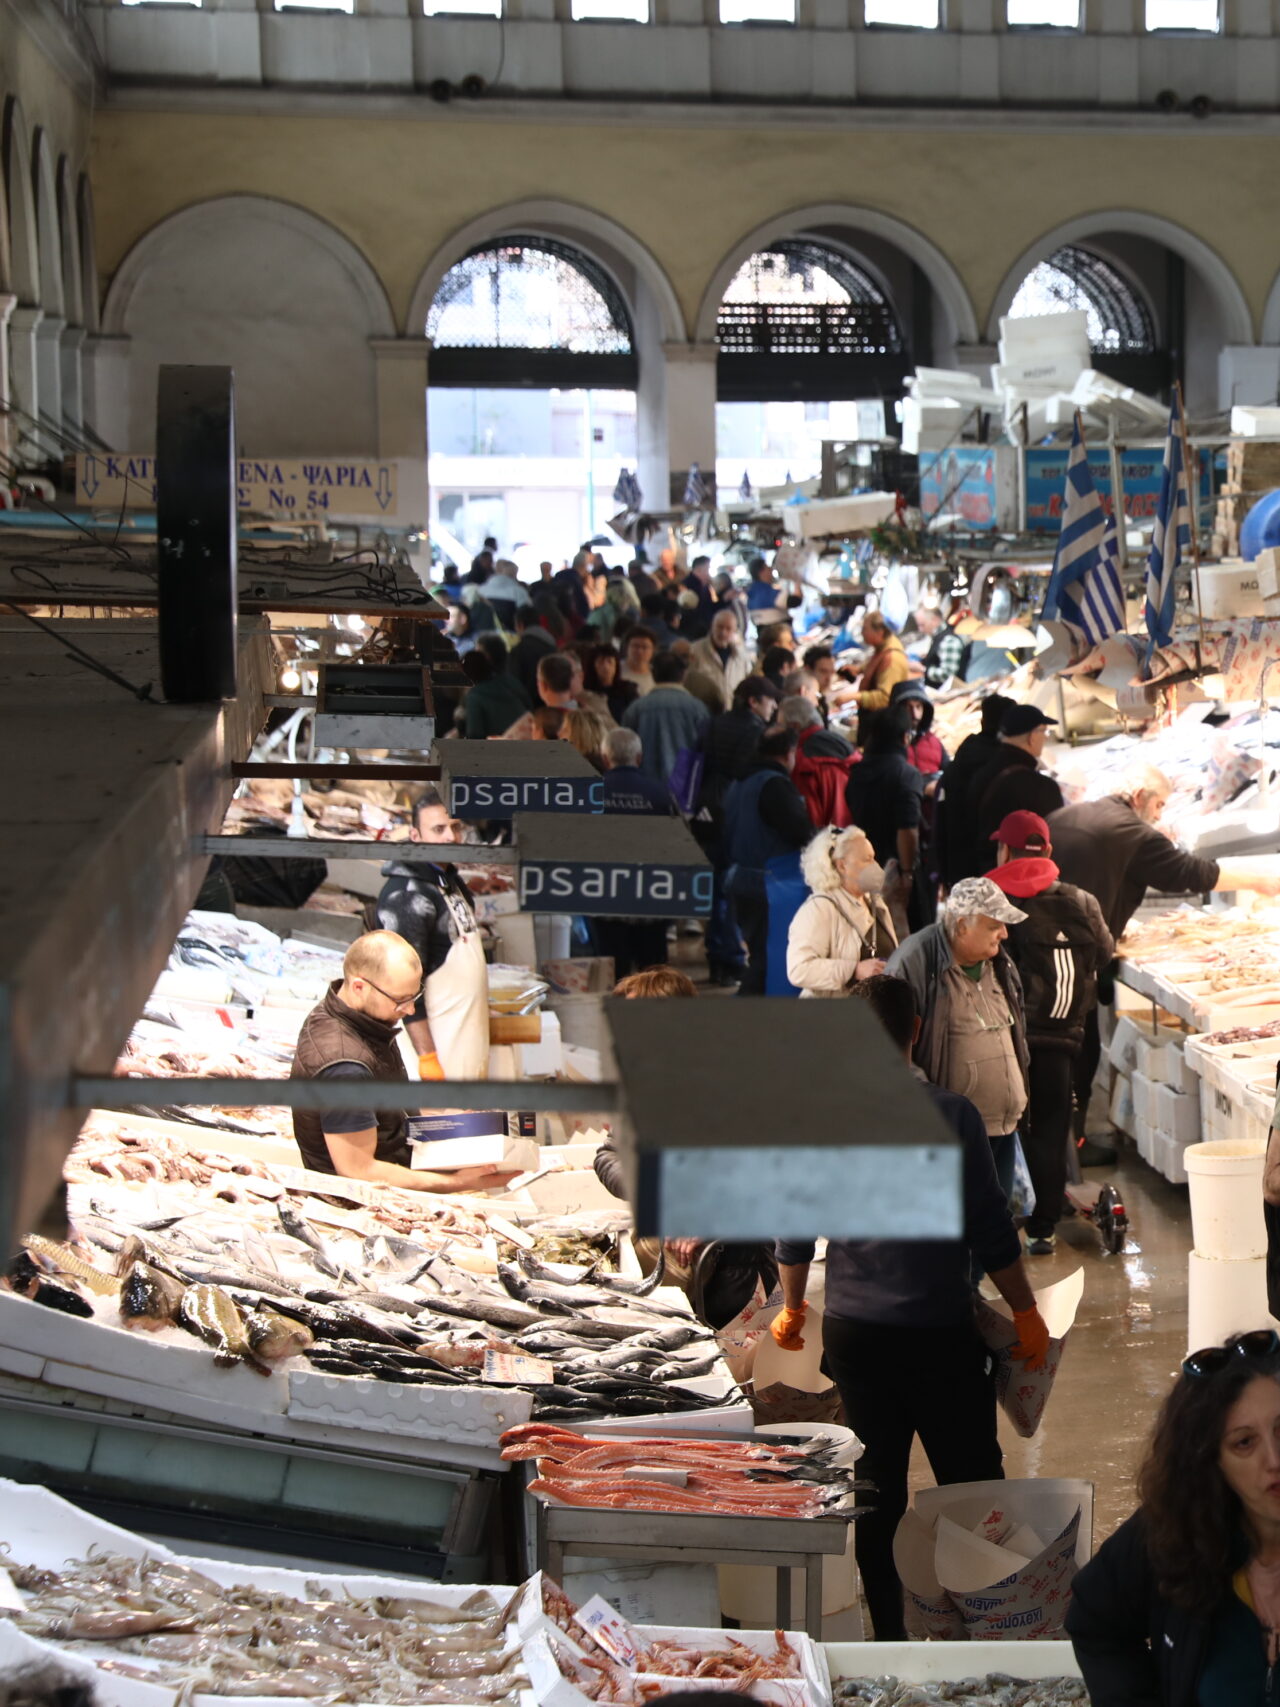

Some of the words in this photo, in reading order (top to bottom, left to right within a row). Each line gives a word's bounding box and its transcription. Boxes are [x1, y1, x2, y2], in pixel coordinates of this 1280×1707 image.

[303, 464, 373, 489] ΨΑΡΙΑ
[268, 490, 296, 510] No
[307, 490, 330, 510] 54
